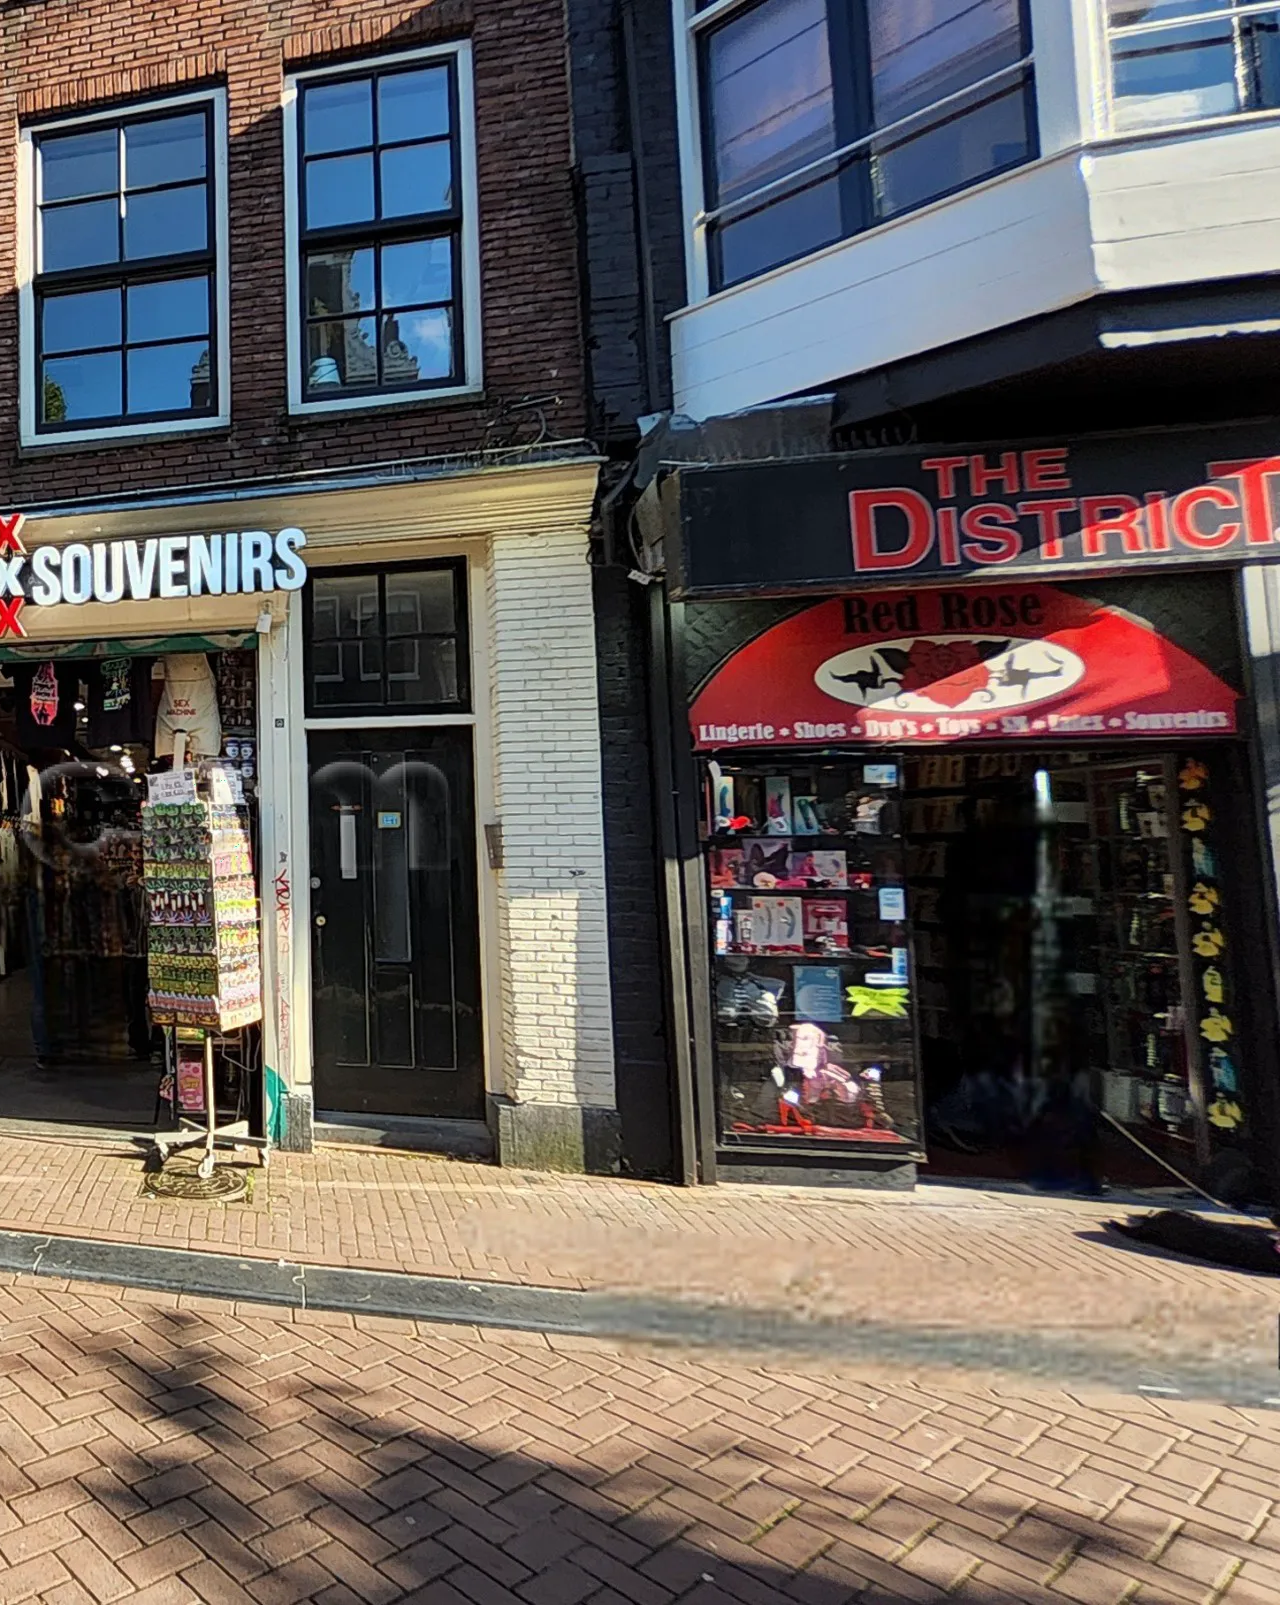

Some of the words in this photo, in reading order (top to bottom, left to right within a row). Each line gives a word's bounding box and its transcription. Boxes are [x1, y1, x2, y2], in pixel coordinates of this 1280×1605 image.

[921, 448, 1071, 499] THE
[849, 456, 1280, 572] DISTRICT
[31, 527, 307, 606] SOUVENIRS
[843, 594, 918, 633] Red
[941, 592, 1045, 629] Rose
[699, 723, 774, 742] Lingerie
[793, 721, 846, 739] Shoes
[935, 717, 981, 737] Toys
[1124, 710, 1229, 730] Souvenirs
